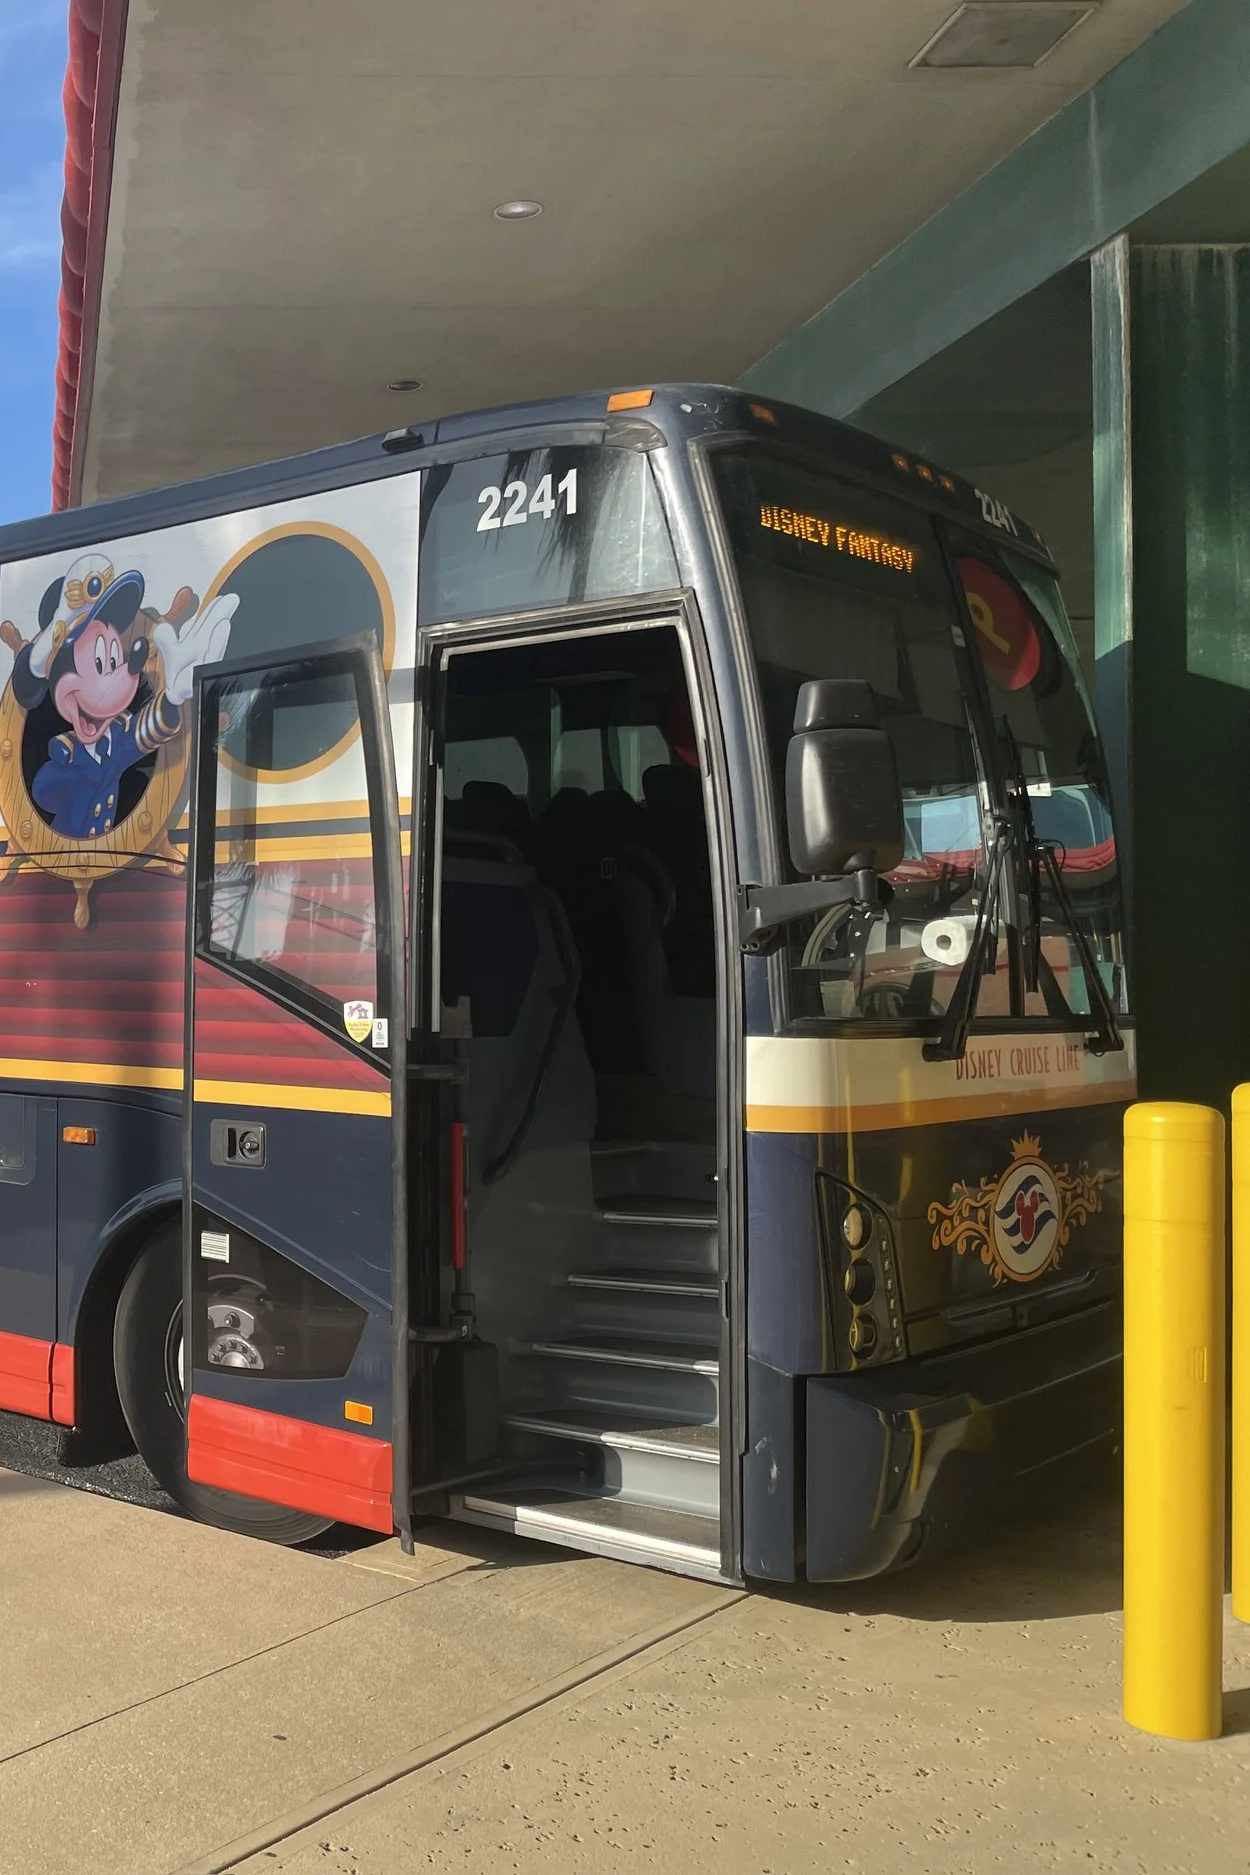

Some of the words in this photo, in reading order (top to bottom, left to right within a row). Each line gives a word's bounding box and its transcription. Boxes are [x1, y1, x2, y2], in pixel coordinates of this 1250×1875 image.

[477, 468, 577, 532] 2241
[760, 505, 829, 546] DISNEY
[835, 526, 913, 573] FANTASY
[956, 1049, 1001, 1080] DISNEY
[1010, 1046, 1050, 1076] CRUISE
[1056, 1044, 1080, 1072] LINE
